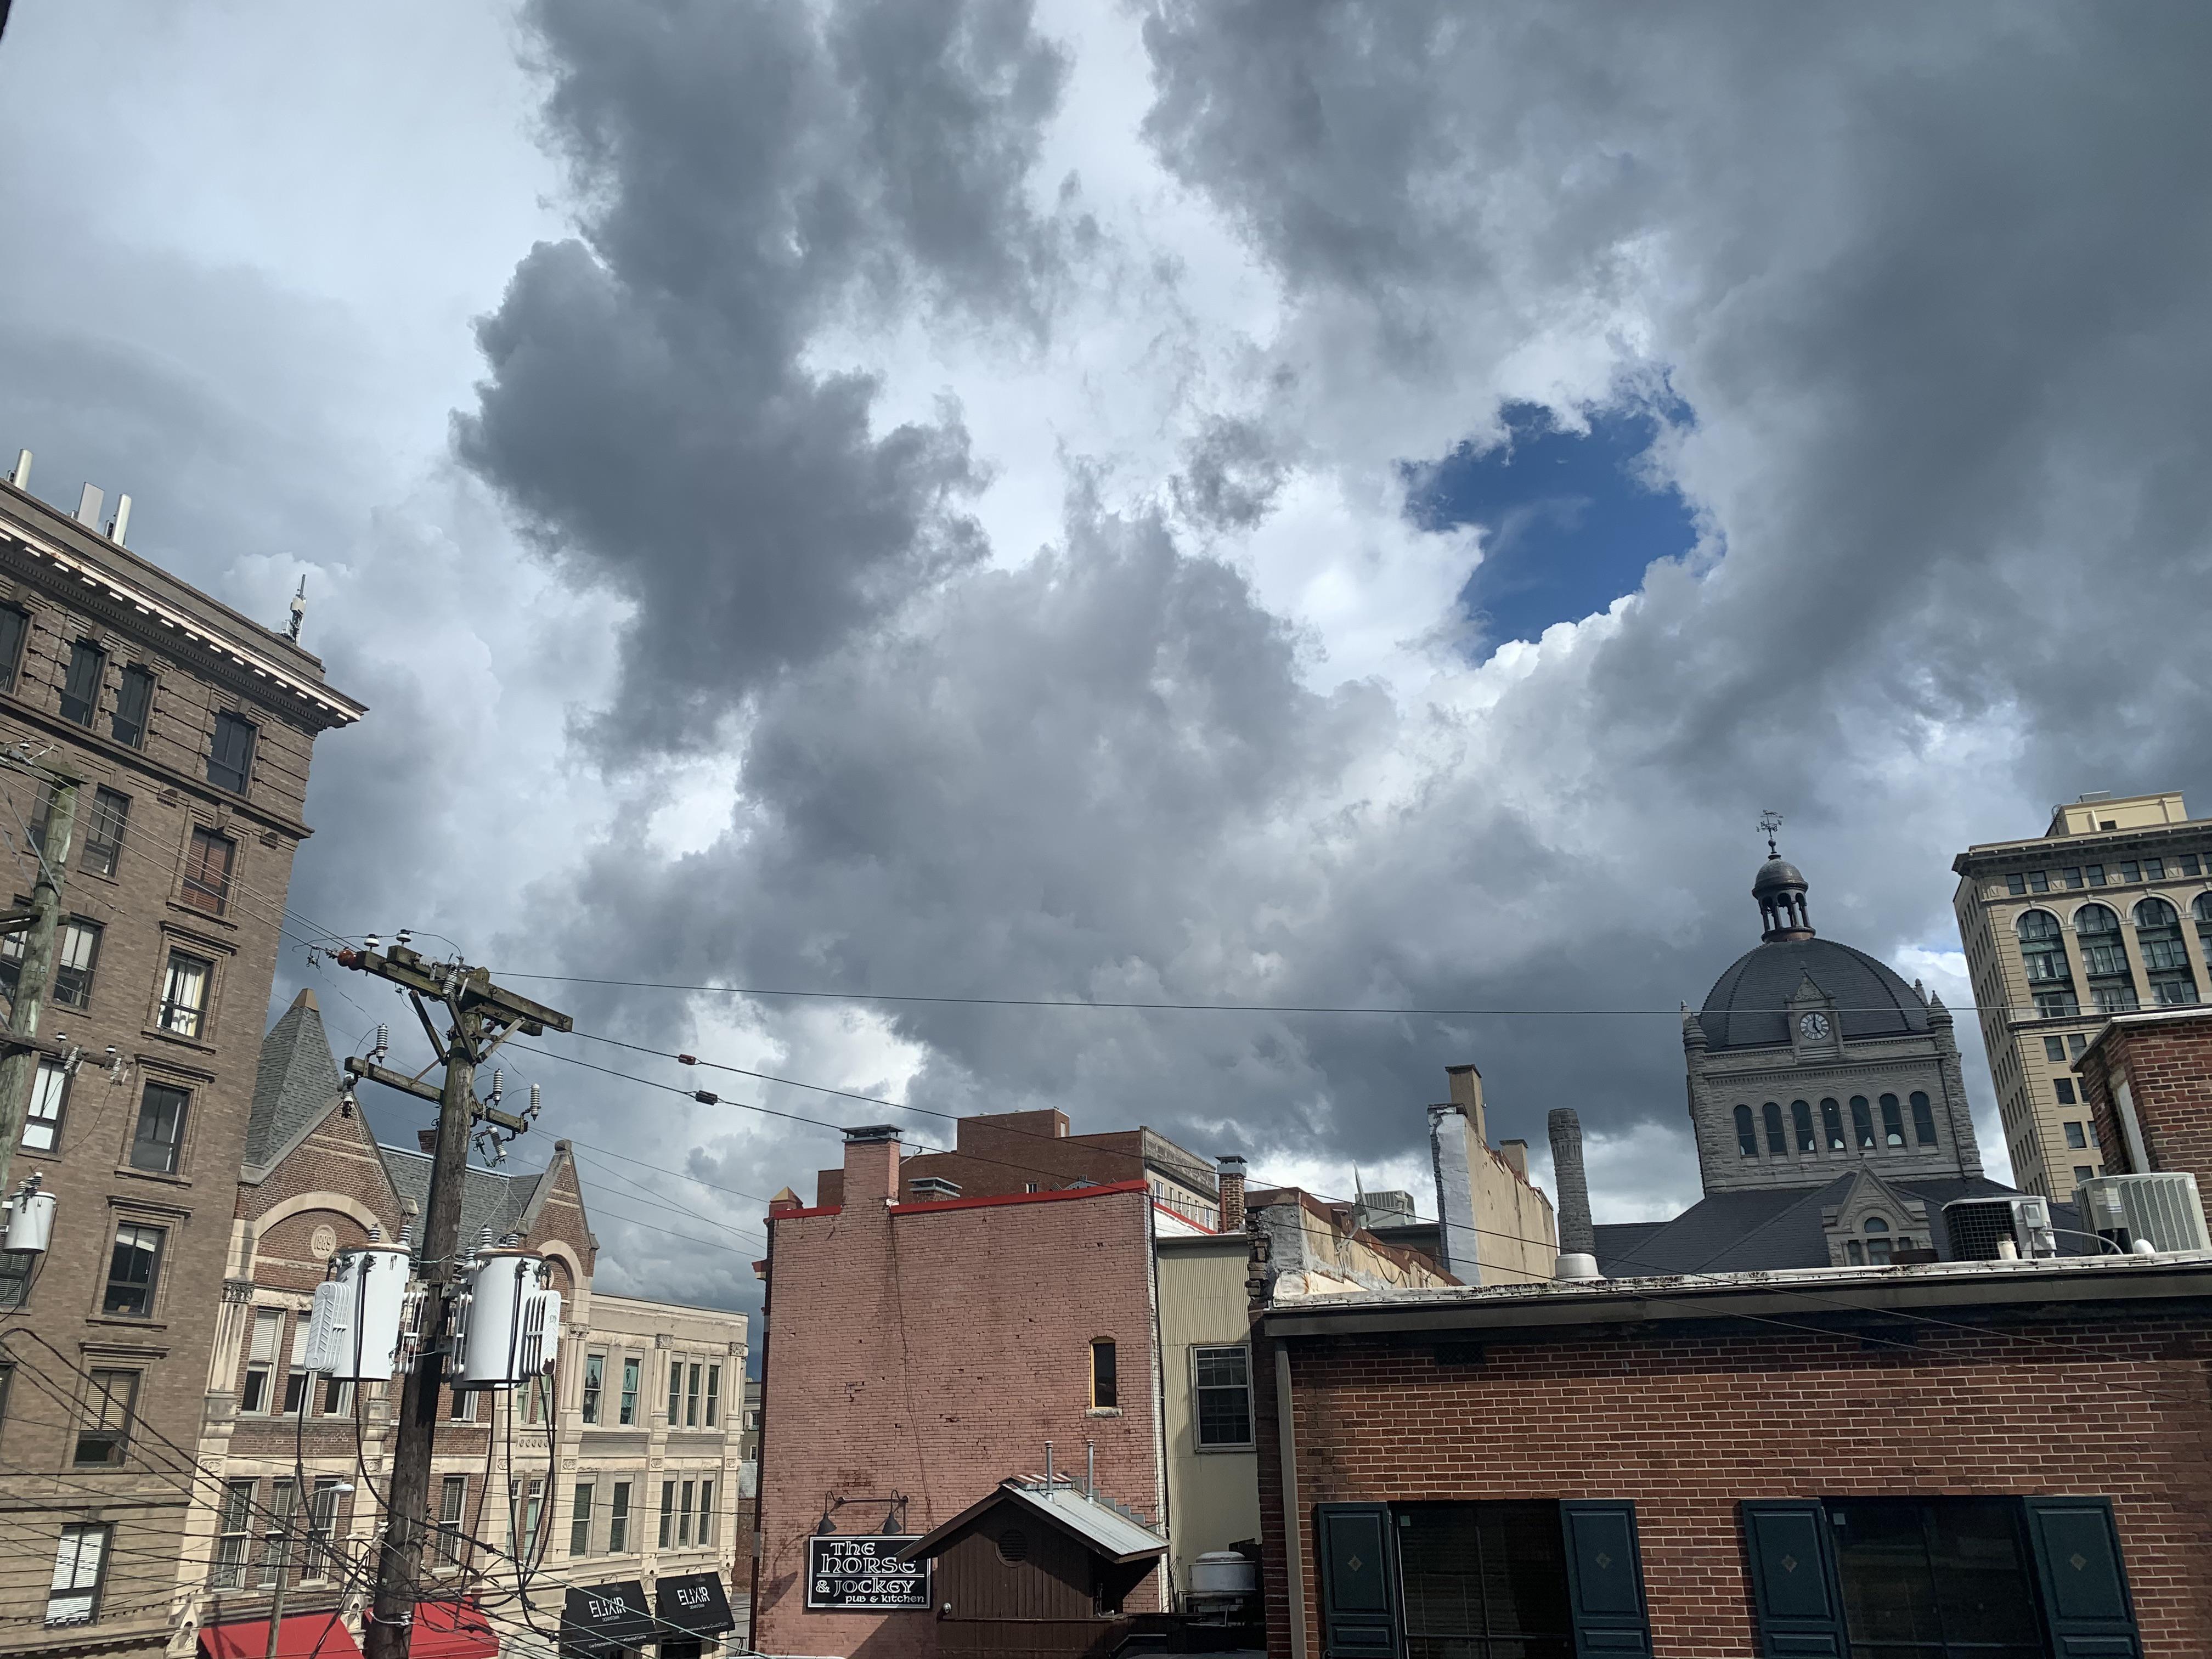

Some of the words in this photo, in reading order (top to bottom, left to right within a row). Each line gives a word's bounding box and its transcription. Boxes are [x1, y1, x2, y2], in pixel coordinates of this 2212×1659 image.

[314, 1233, 332, 1251] 1889
[821, 1554, 916, 1573] HORSE
[677, 1587, 710, 1605] ELIXIR
[816, 1580, 831, 1593] &
[833, 1578, 915, 1597] JOCKEY
[589, 1597, 626, 1617] ELIXIR
[882, 1595, 924, 1603] kitchen
